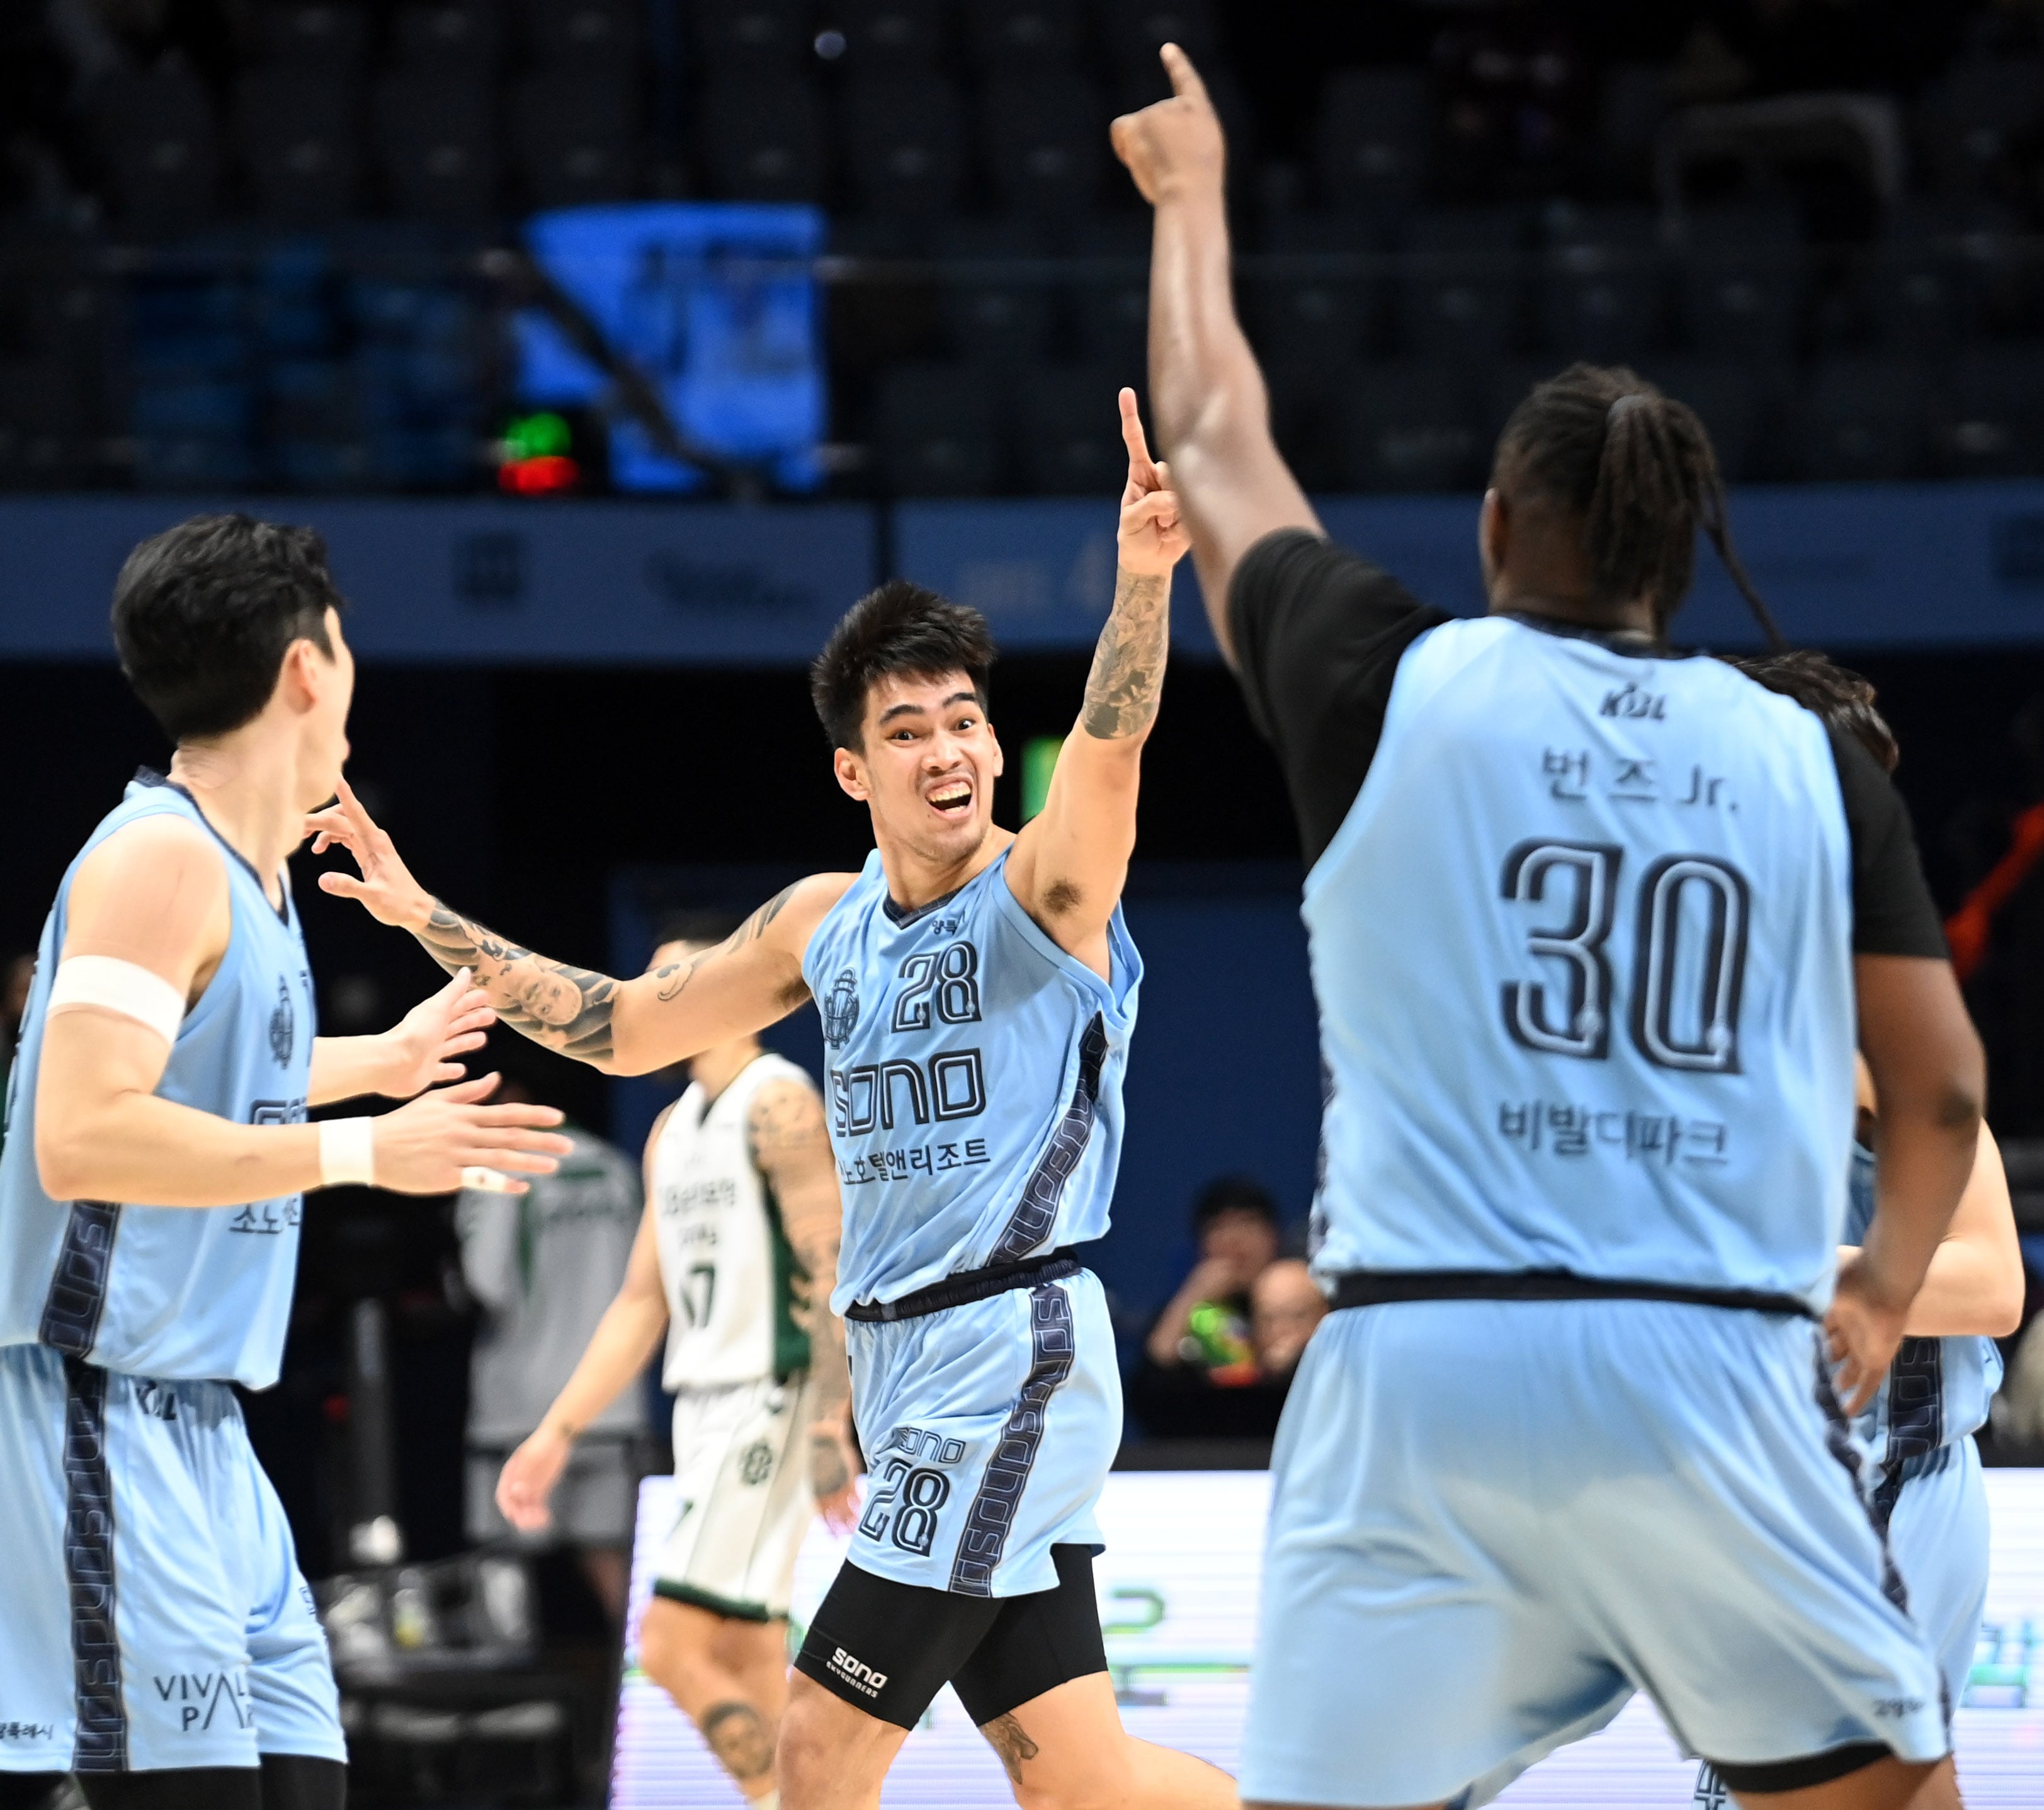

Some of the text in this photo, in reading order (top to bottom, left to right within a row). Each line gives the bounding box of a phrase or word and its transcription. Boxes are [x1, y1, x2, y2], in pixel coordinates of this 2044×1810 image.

[1675, 764, 1738, 811] Jr.
[892, 940, 982, 1033] 28
[1500, 836, 1751, 1075] 30
[1498, 1100, 1729, 1168] 비발디파크
[858, 1457, 950, 1557] 28
